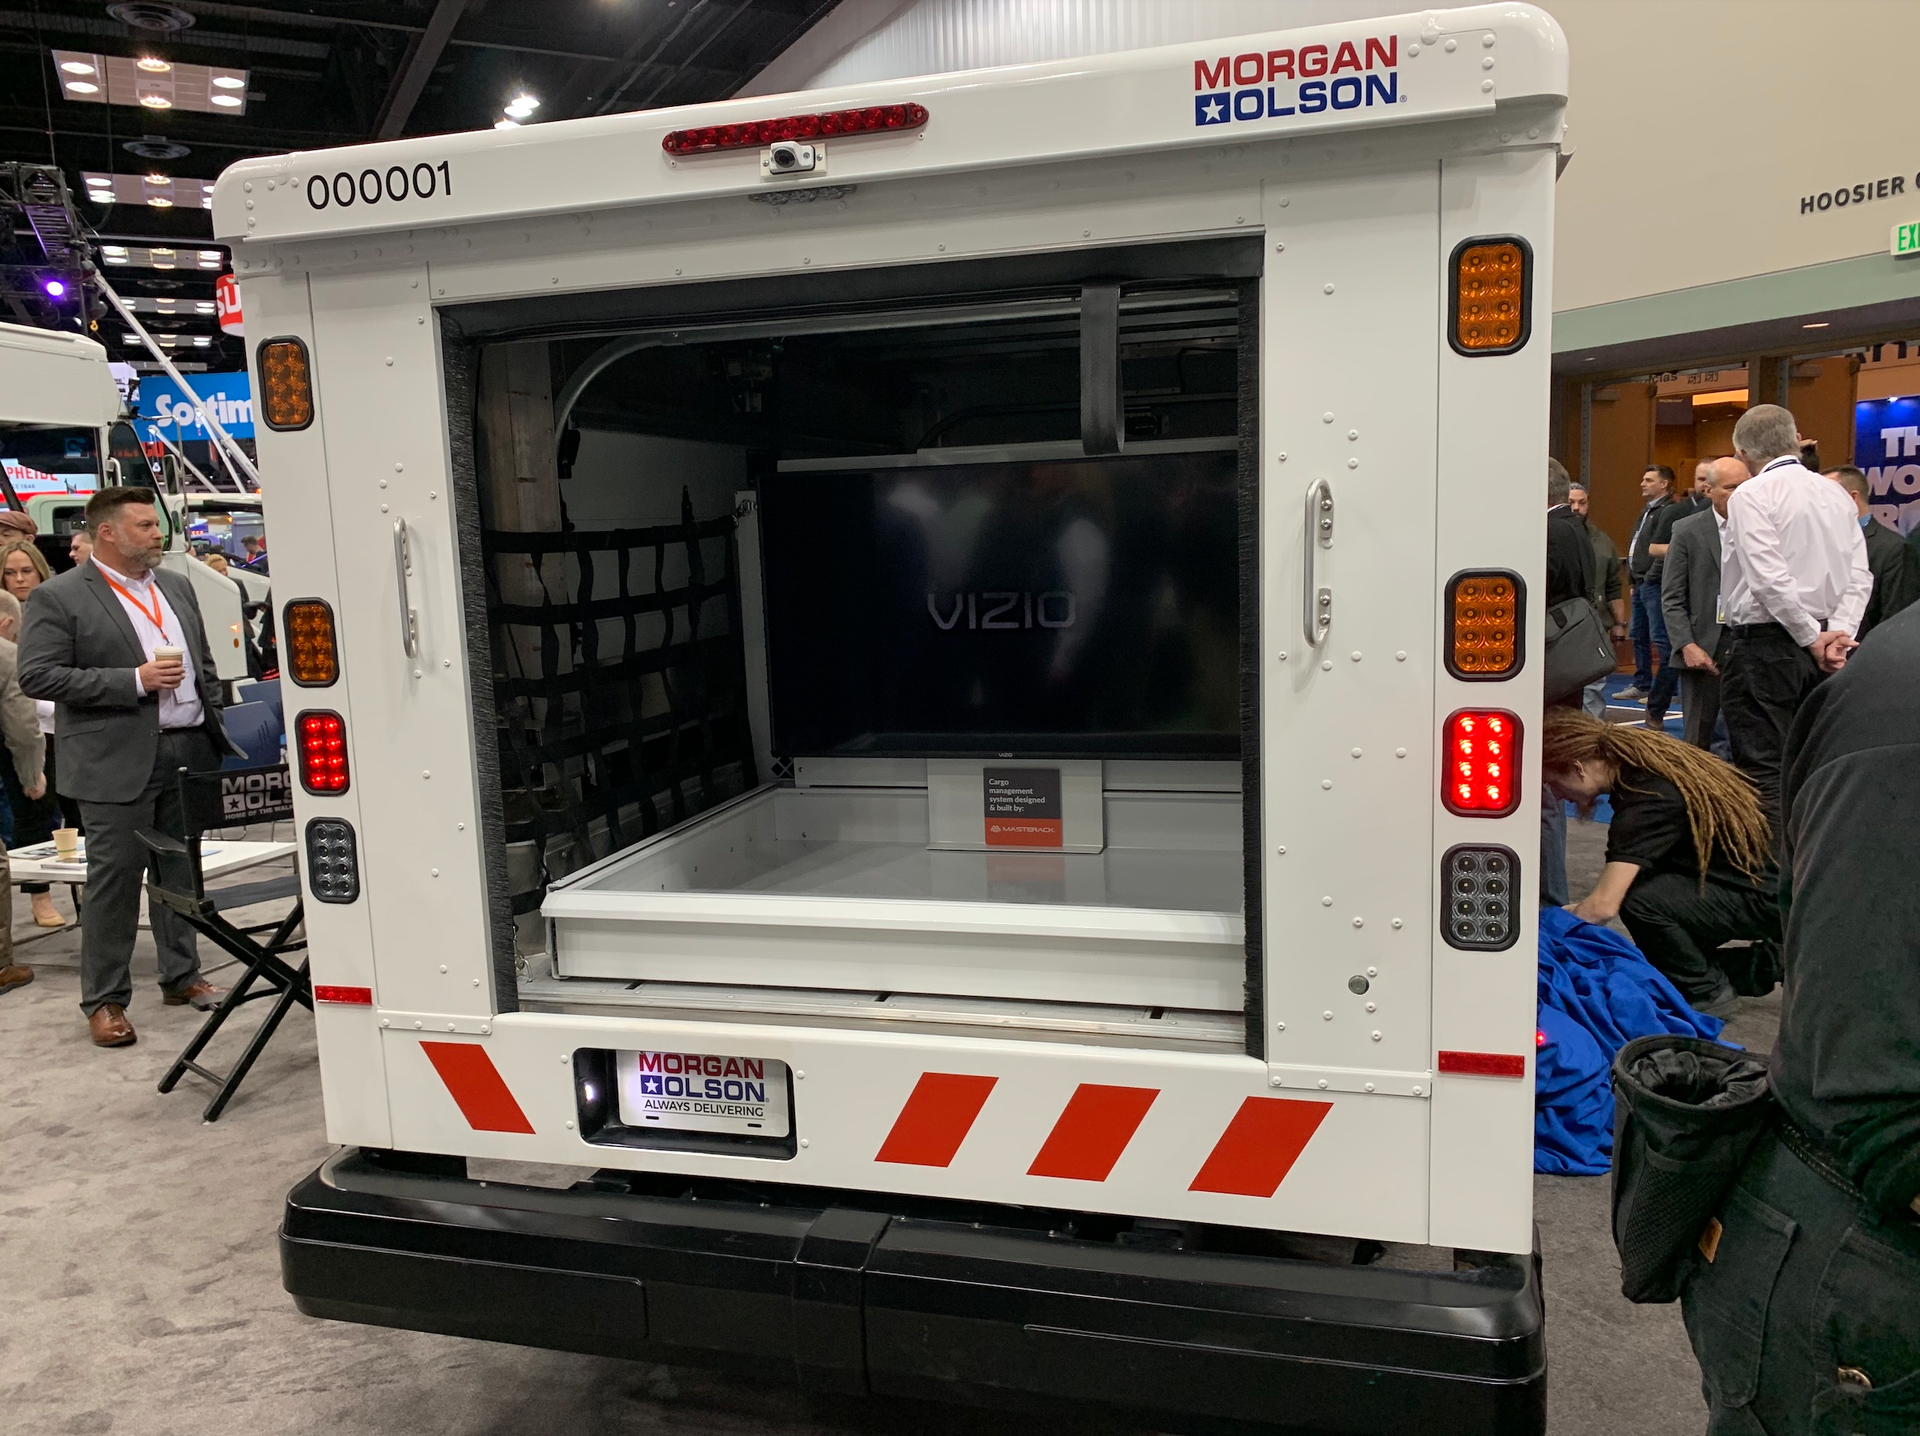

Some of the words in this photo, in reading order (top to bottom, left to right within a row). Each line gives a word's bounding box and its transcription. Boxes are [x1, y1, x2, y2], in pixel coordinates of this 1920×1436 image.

[1194, 34, 1398, 91] MORGAN
[1233, 71, 1398, 122] OLSON
[307, 160, 452, 210] 000001
[1800, 176, 1905, 215] HOOSIER
[927, 591, 1077, 631] VIZIO
[988, 778, 1010, 787] Cargo
[988, 787, 1034, 796] management
[989, 796, 1014, 804] system
[1014, 796, 1046, 805] designed
[989, 804, 996, 812] &
[996, 804, 1013, 812] built
[1013, 804, 1025, 813] by:
[225, 812, 247, 820] HOME
[259, 807, 273, 815] THE
[1002, 826, 1056, 834] MASTERACK
[638, 1052, 764, 1080] MORGAN
[664, 1075, 765, 1103] OLSON
[644, 1098, 691, 1112] ALWAYS
[694, 1102, 764, 1117] DELIVERING
